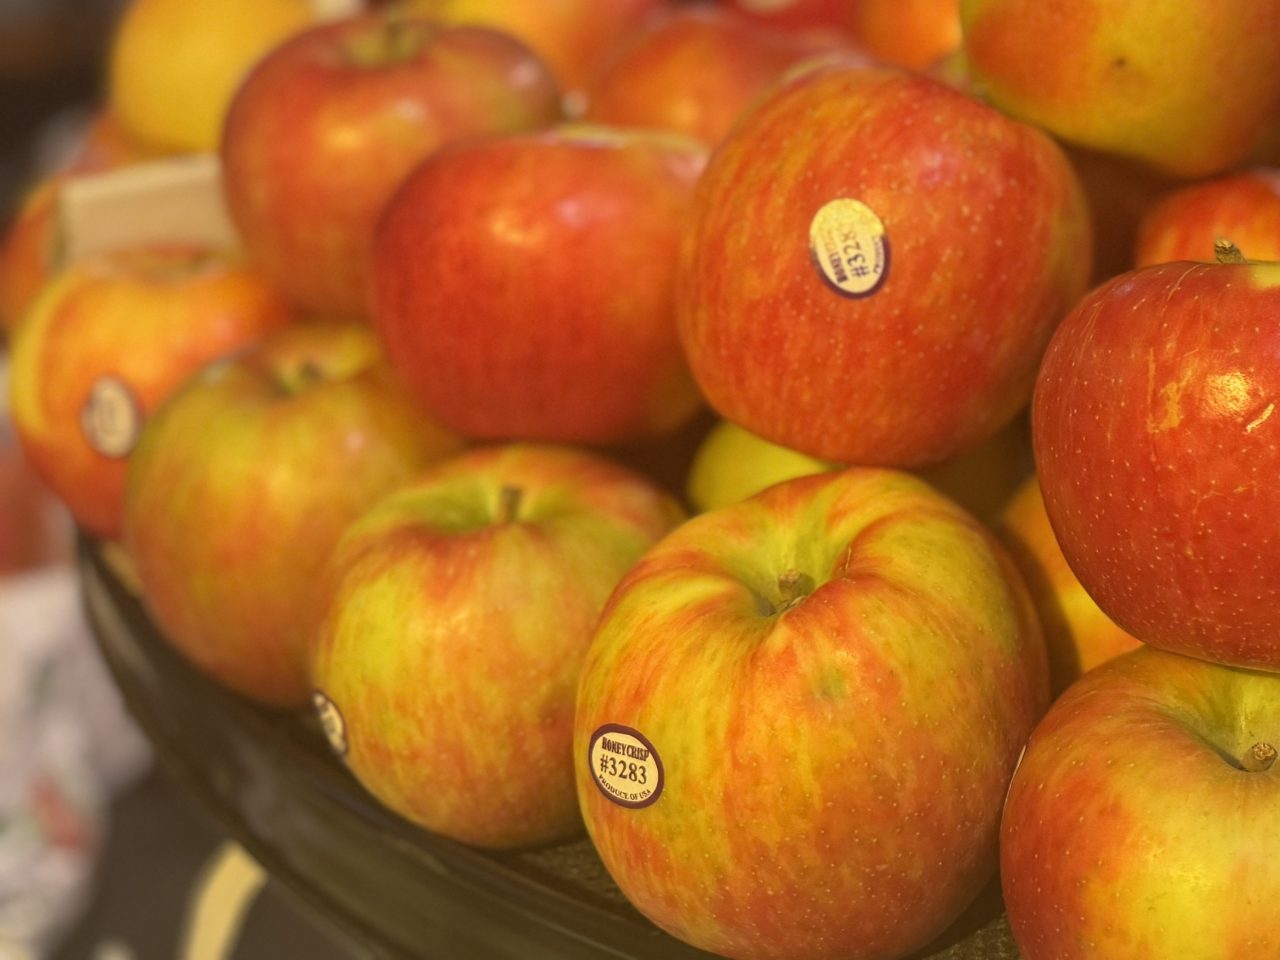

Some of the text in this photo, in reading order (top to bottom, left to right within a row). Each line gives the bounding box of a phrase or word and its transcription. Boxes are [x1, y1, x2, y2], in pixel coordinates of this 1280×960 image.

[602, 736, 650, 761] HONEYCRISP
[600, 754, 647, 785] #3283
[598, 774, 651, 801] PRODUCE OF USA
